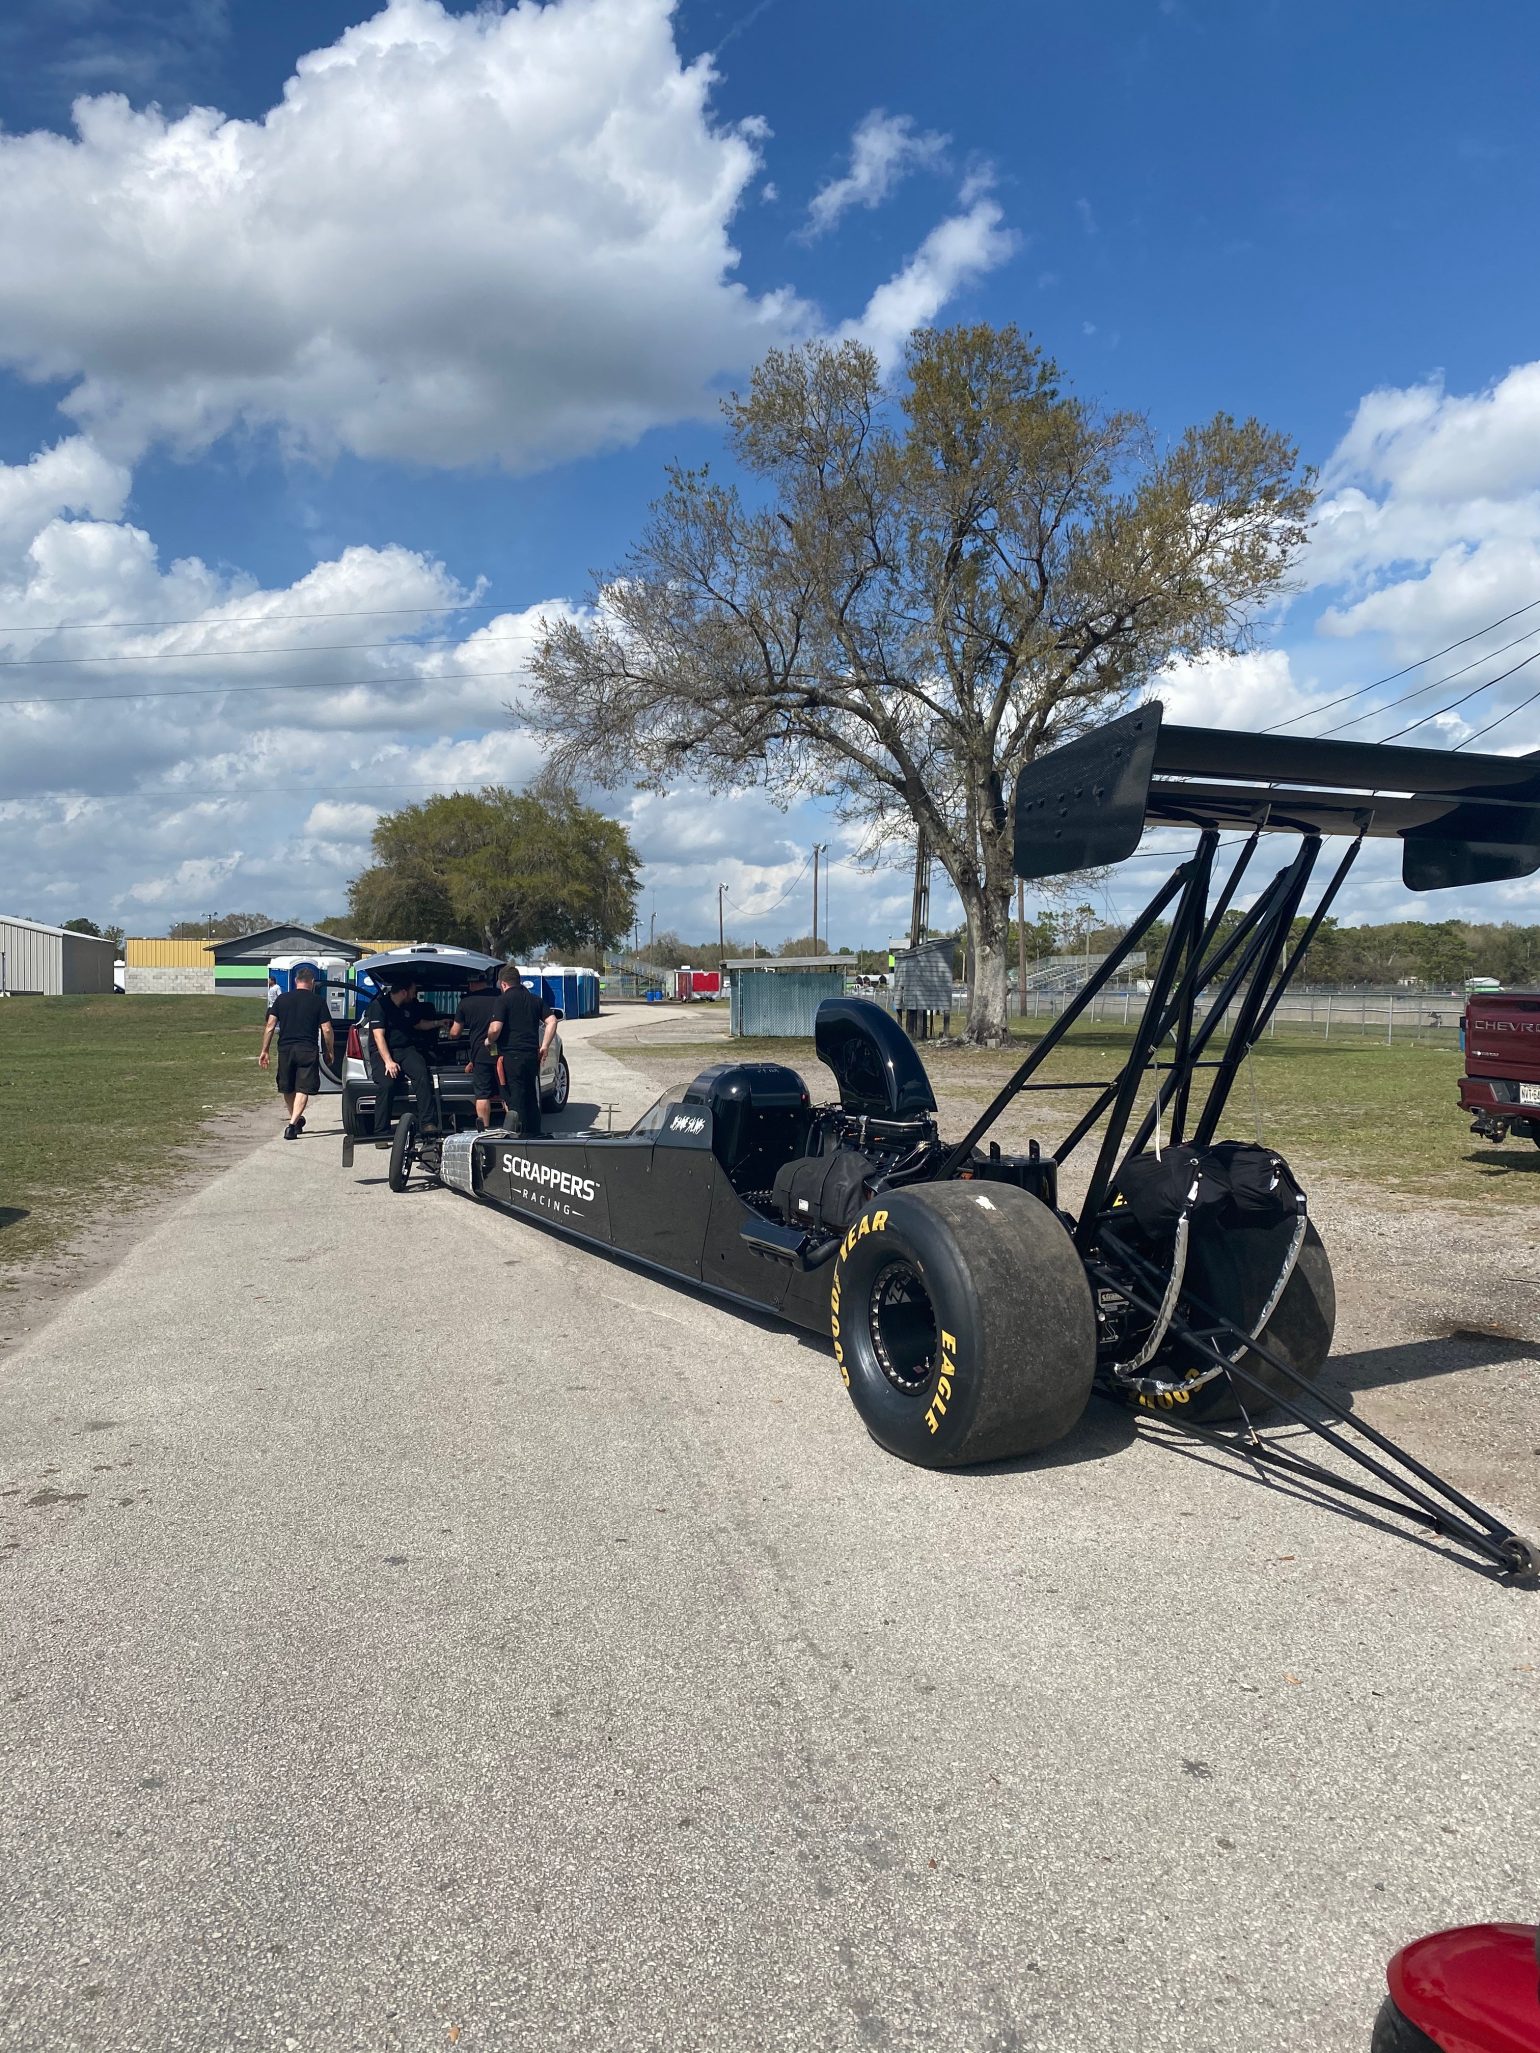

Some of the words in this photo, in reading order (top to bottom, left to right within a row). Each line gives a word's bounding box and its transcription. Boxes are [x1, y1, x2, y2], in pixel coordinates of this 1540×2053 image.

[502, 1153, 596, 1202] SCRAPPERS
[522, 1188, 571, 1215] RACING
[924, 1329, 957, 1435] EAGLE
